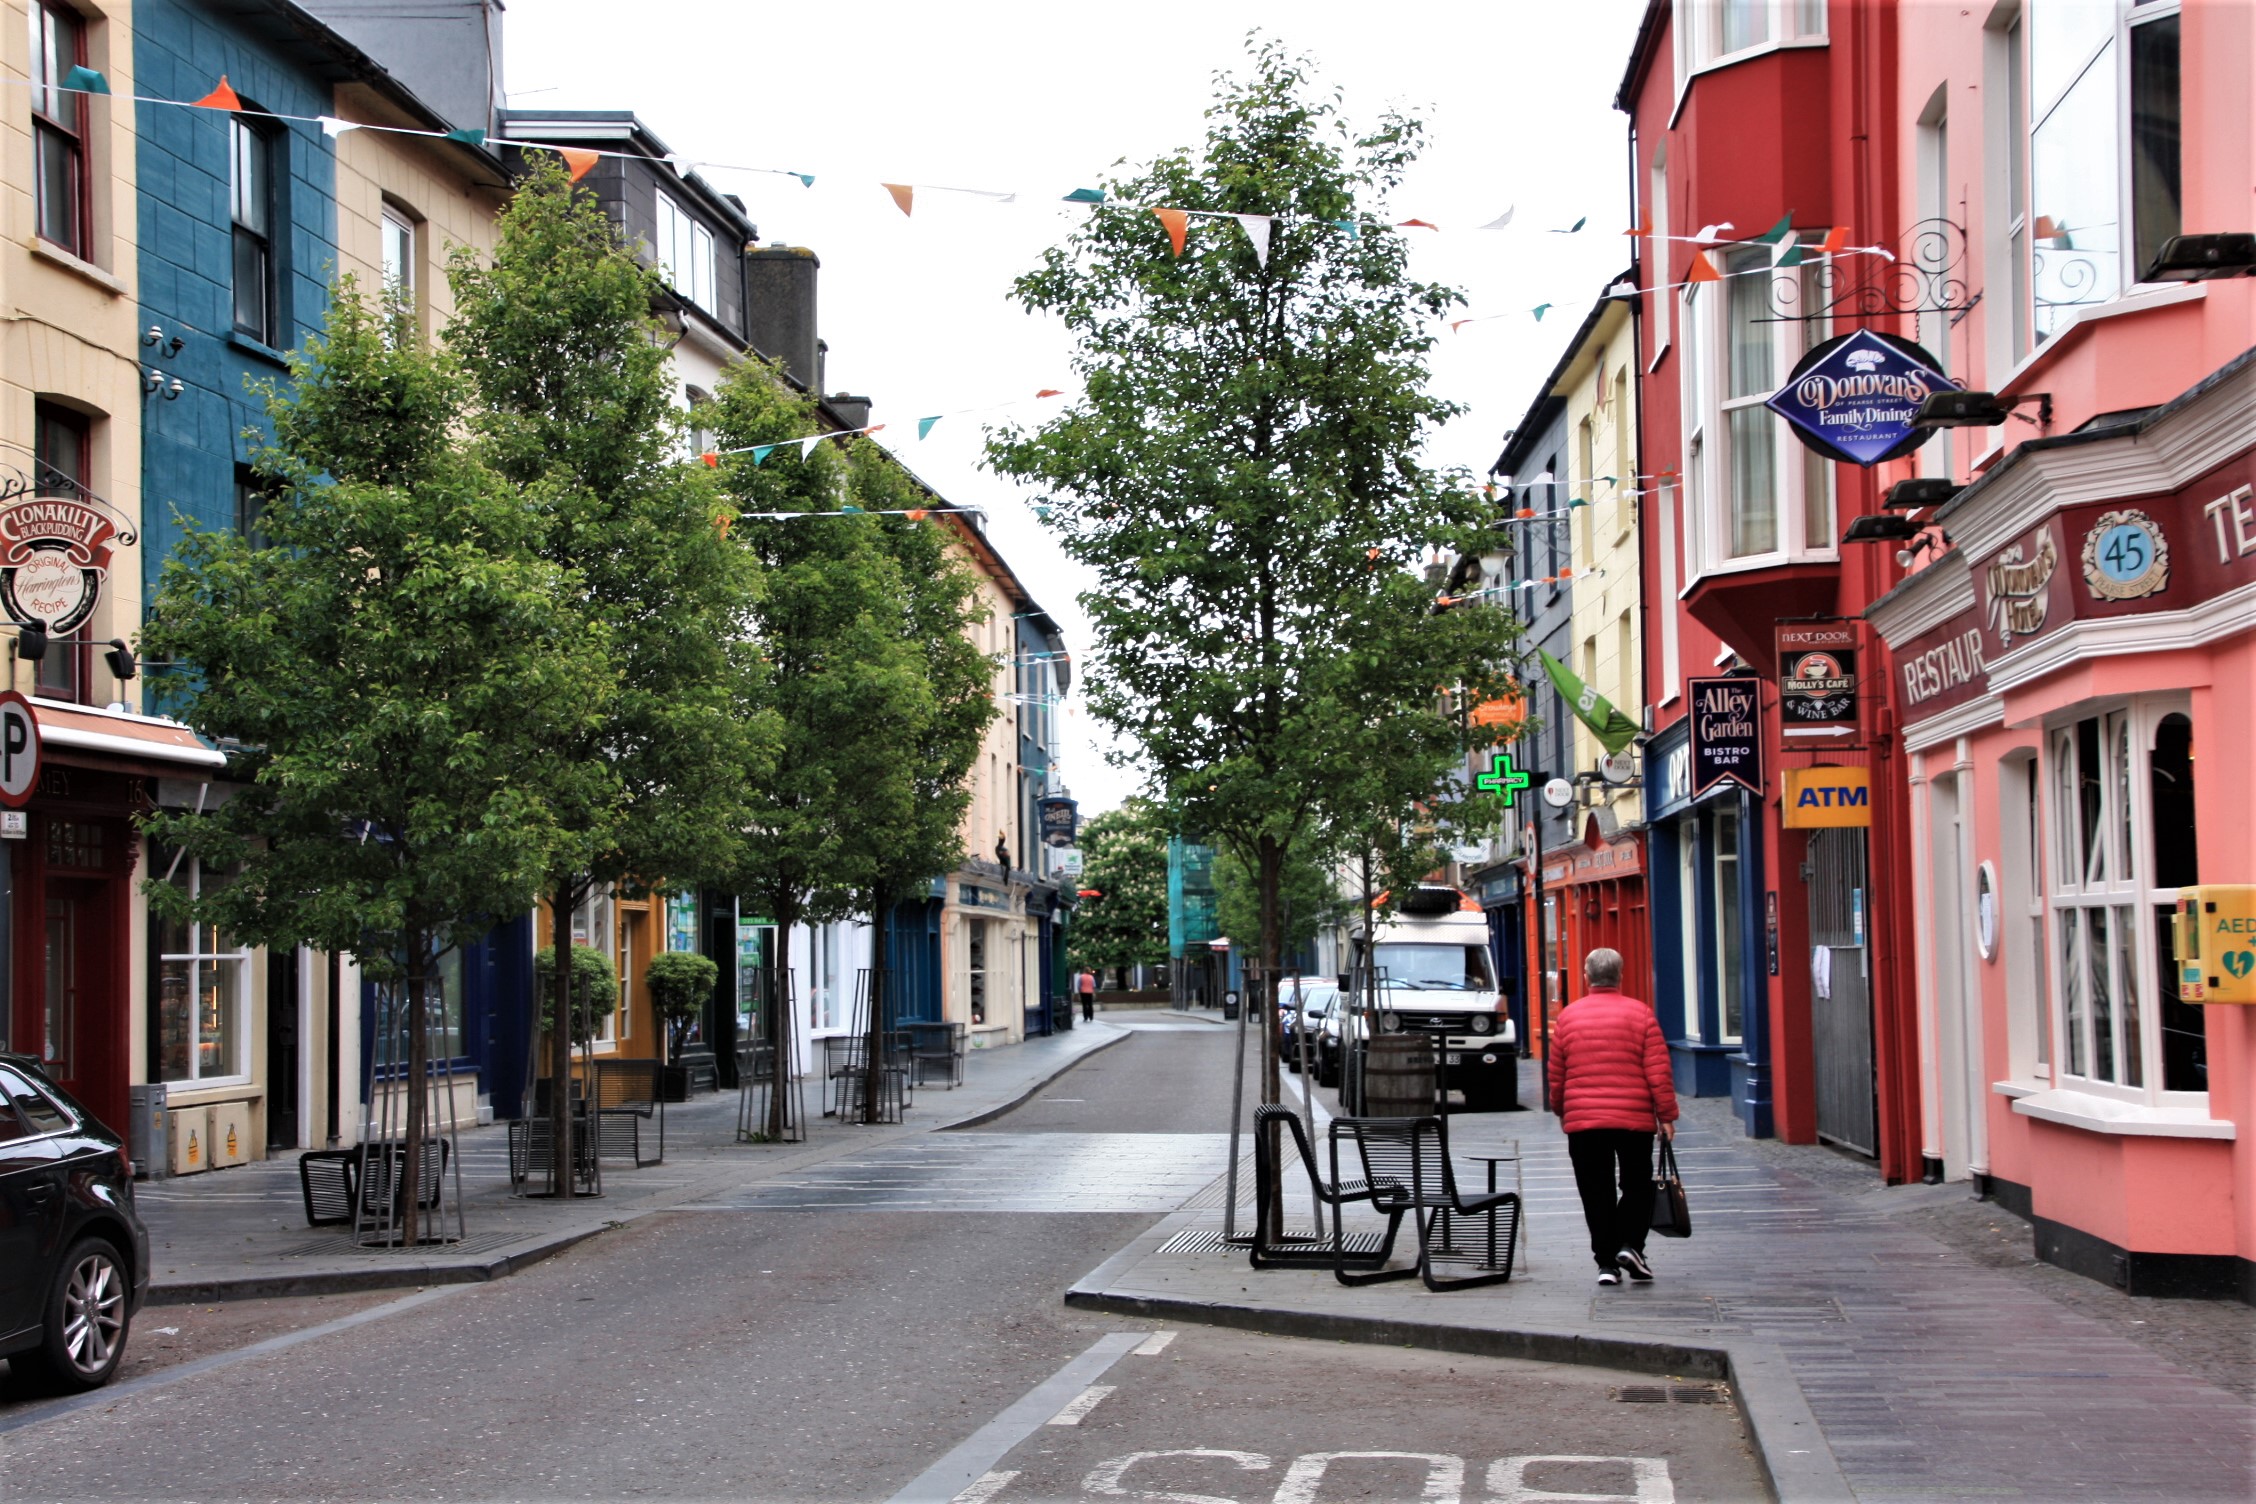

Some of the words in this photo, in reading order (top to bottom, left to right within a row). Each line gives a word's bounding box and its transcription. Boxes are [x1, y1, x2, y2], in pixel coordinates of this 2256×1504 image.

[1819, 408, 1867, 432] Family
[1866, 407, 1914, 428] Dining
[1836, 433, 1898, 442] RESTAURANT
[0, 504, 106, 546] CLONAKILTY
[2105, 532, 2144, 573] 45
[27, 556, 70, 574] ORIGINAL
[31, 597, 68, 614] RECIPE
[1815, 632, 1853, 641] DOOR
[1696, 688, 1754, 721] Alley
[1797, 706, 1828, 719] WINE
[1830, 697, 1851, 716] BAR
[1701, 714, 1753, 742] Garden
[4, 712, 27, 782] P
[1704, 747, 1750, 756] BISTRO
[1714, 756, 1739, 764] BAR
[128, 779, 142, 804] 16
[1797, 787, 1867, 807] ATM
[2217, 918, 2256, 933] AED
